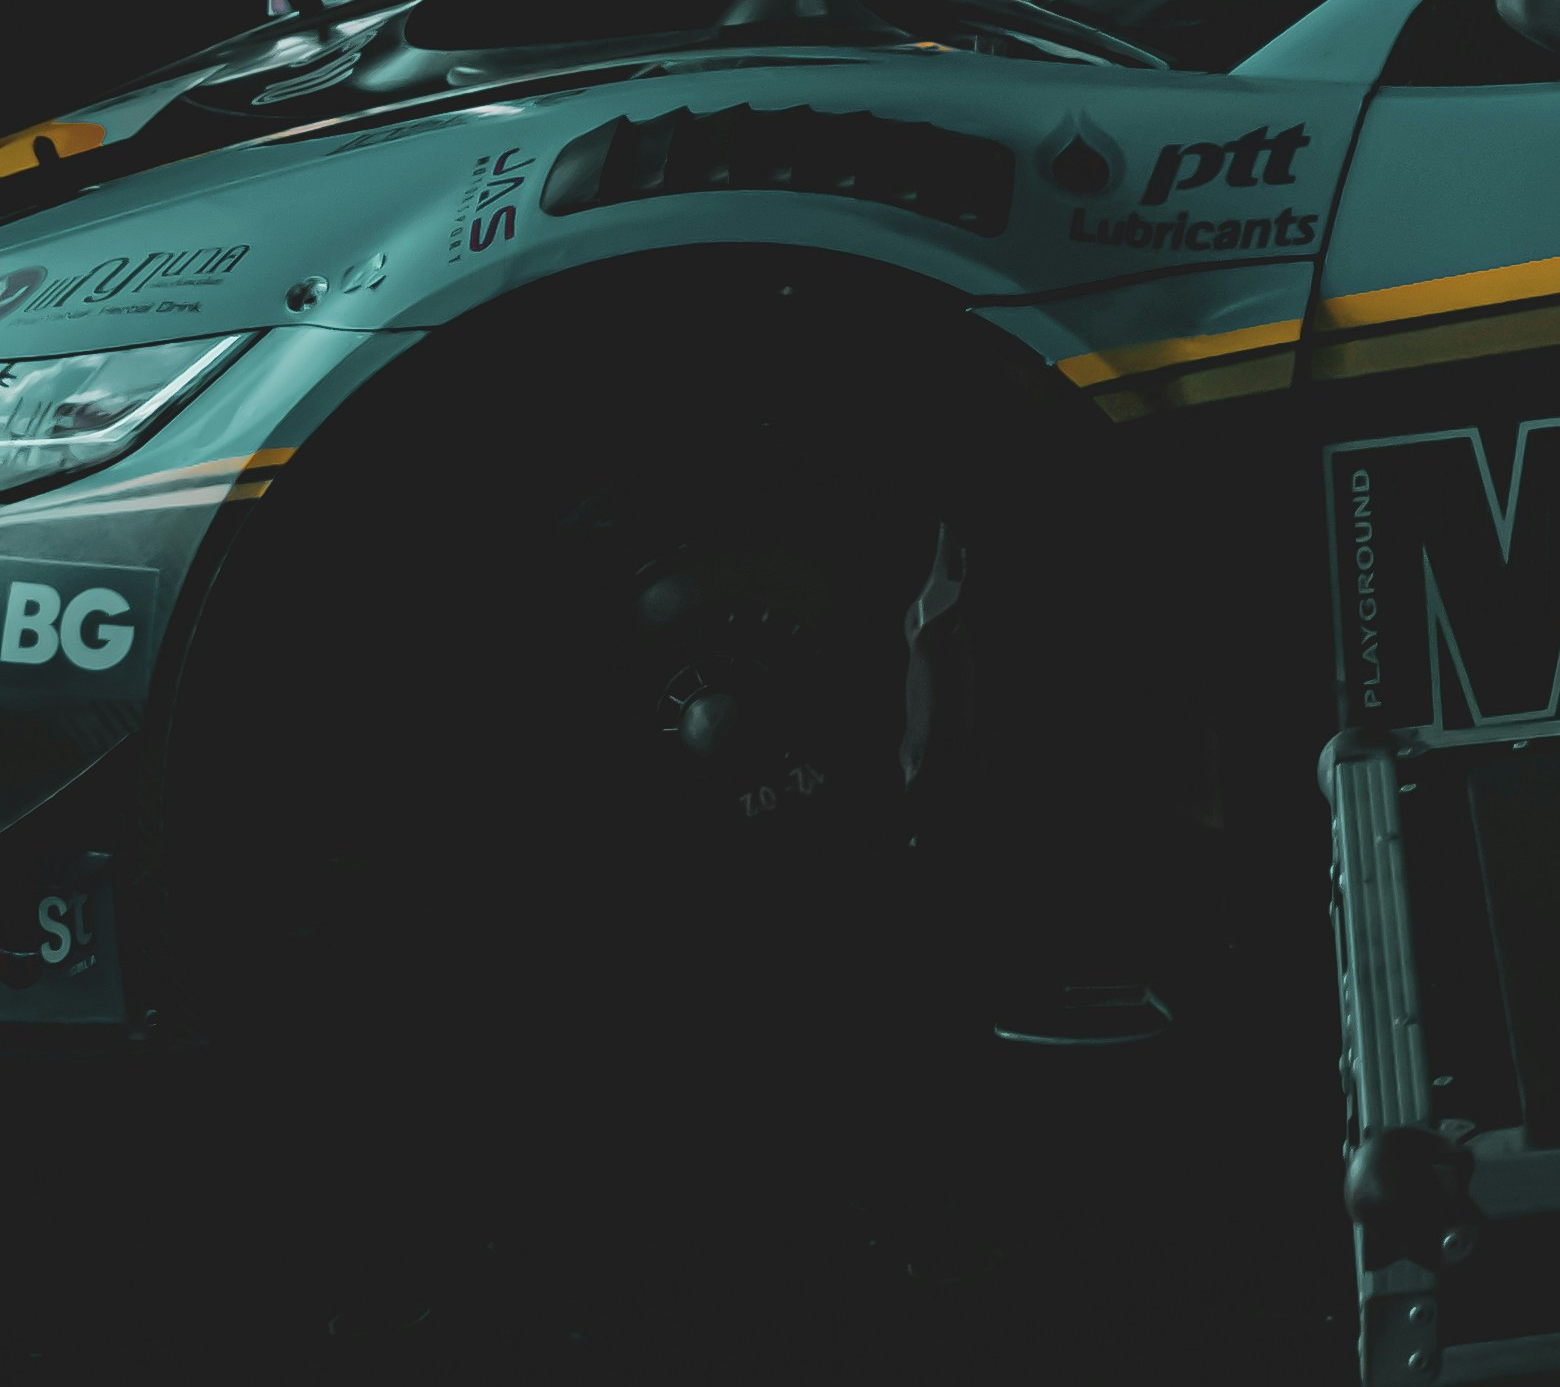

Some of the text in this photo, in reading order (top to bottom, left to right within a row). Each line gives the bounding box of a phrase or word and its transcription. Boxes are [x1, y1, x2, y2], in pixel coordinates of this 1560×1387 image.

[1141, 123, 1311, 206] ptt
[1069, 208, 1319, 252] Lubricants
[0, 582, 135, 671] BG
[1351, 466, 1384, 710] PLAYGROUND
